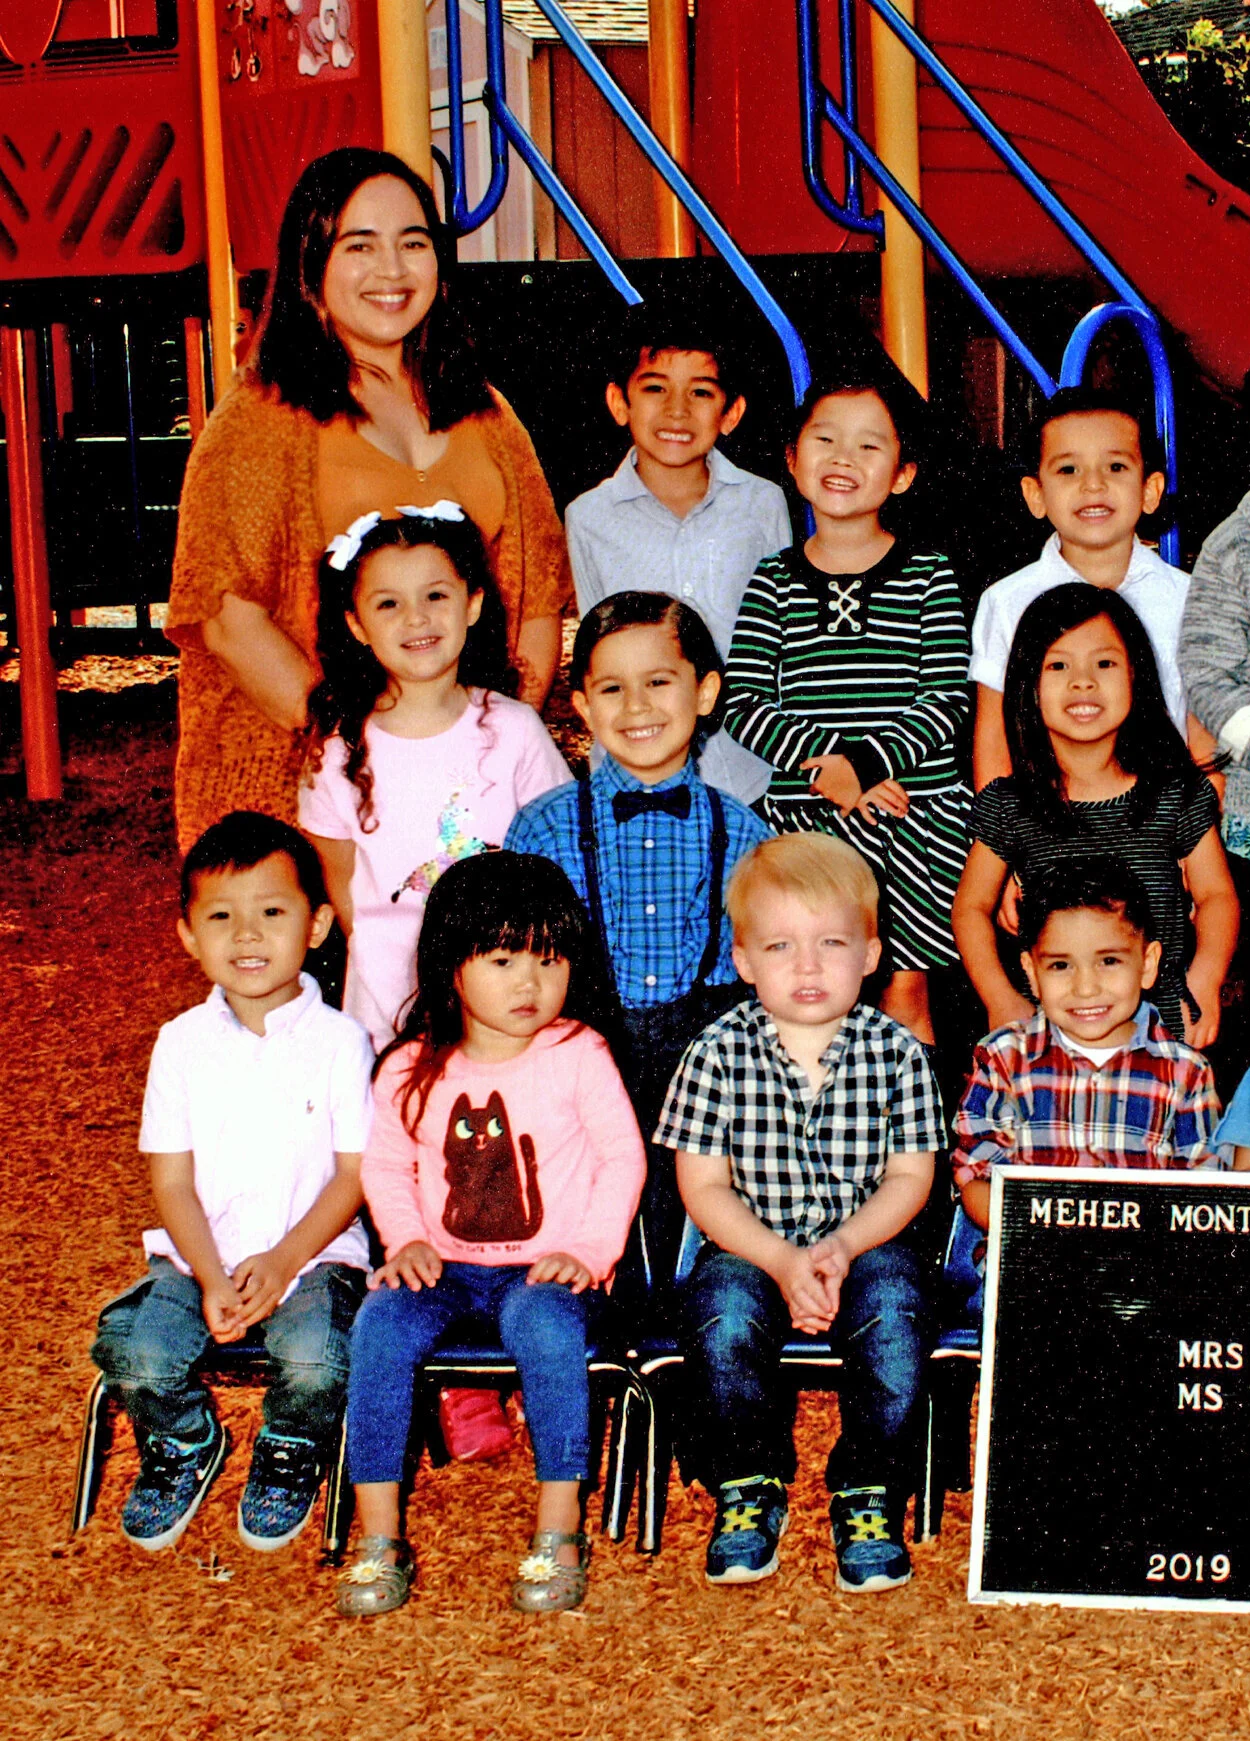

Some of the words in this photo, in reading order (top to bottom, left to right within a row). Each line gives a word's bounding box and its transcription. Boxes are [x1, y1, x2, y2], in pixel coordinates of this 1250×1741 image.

[1030, 1198, 1141, 1229] MEHER
[1178, 1340, 1244, 1370] MRS
[1177, 1383, 1224, 1412] MS
[1146, 1553, 1231, 1582] 2019
